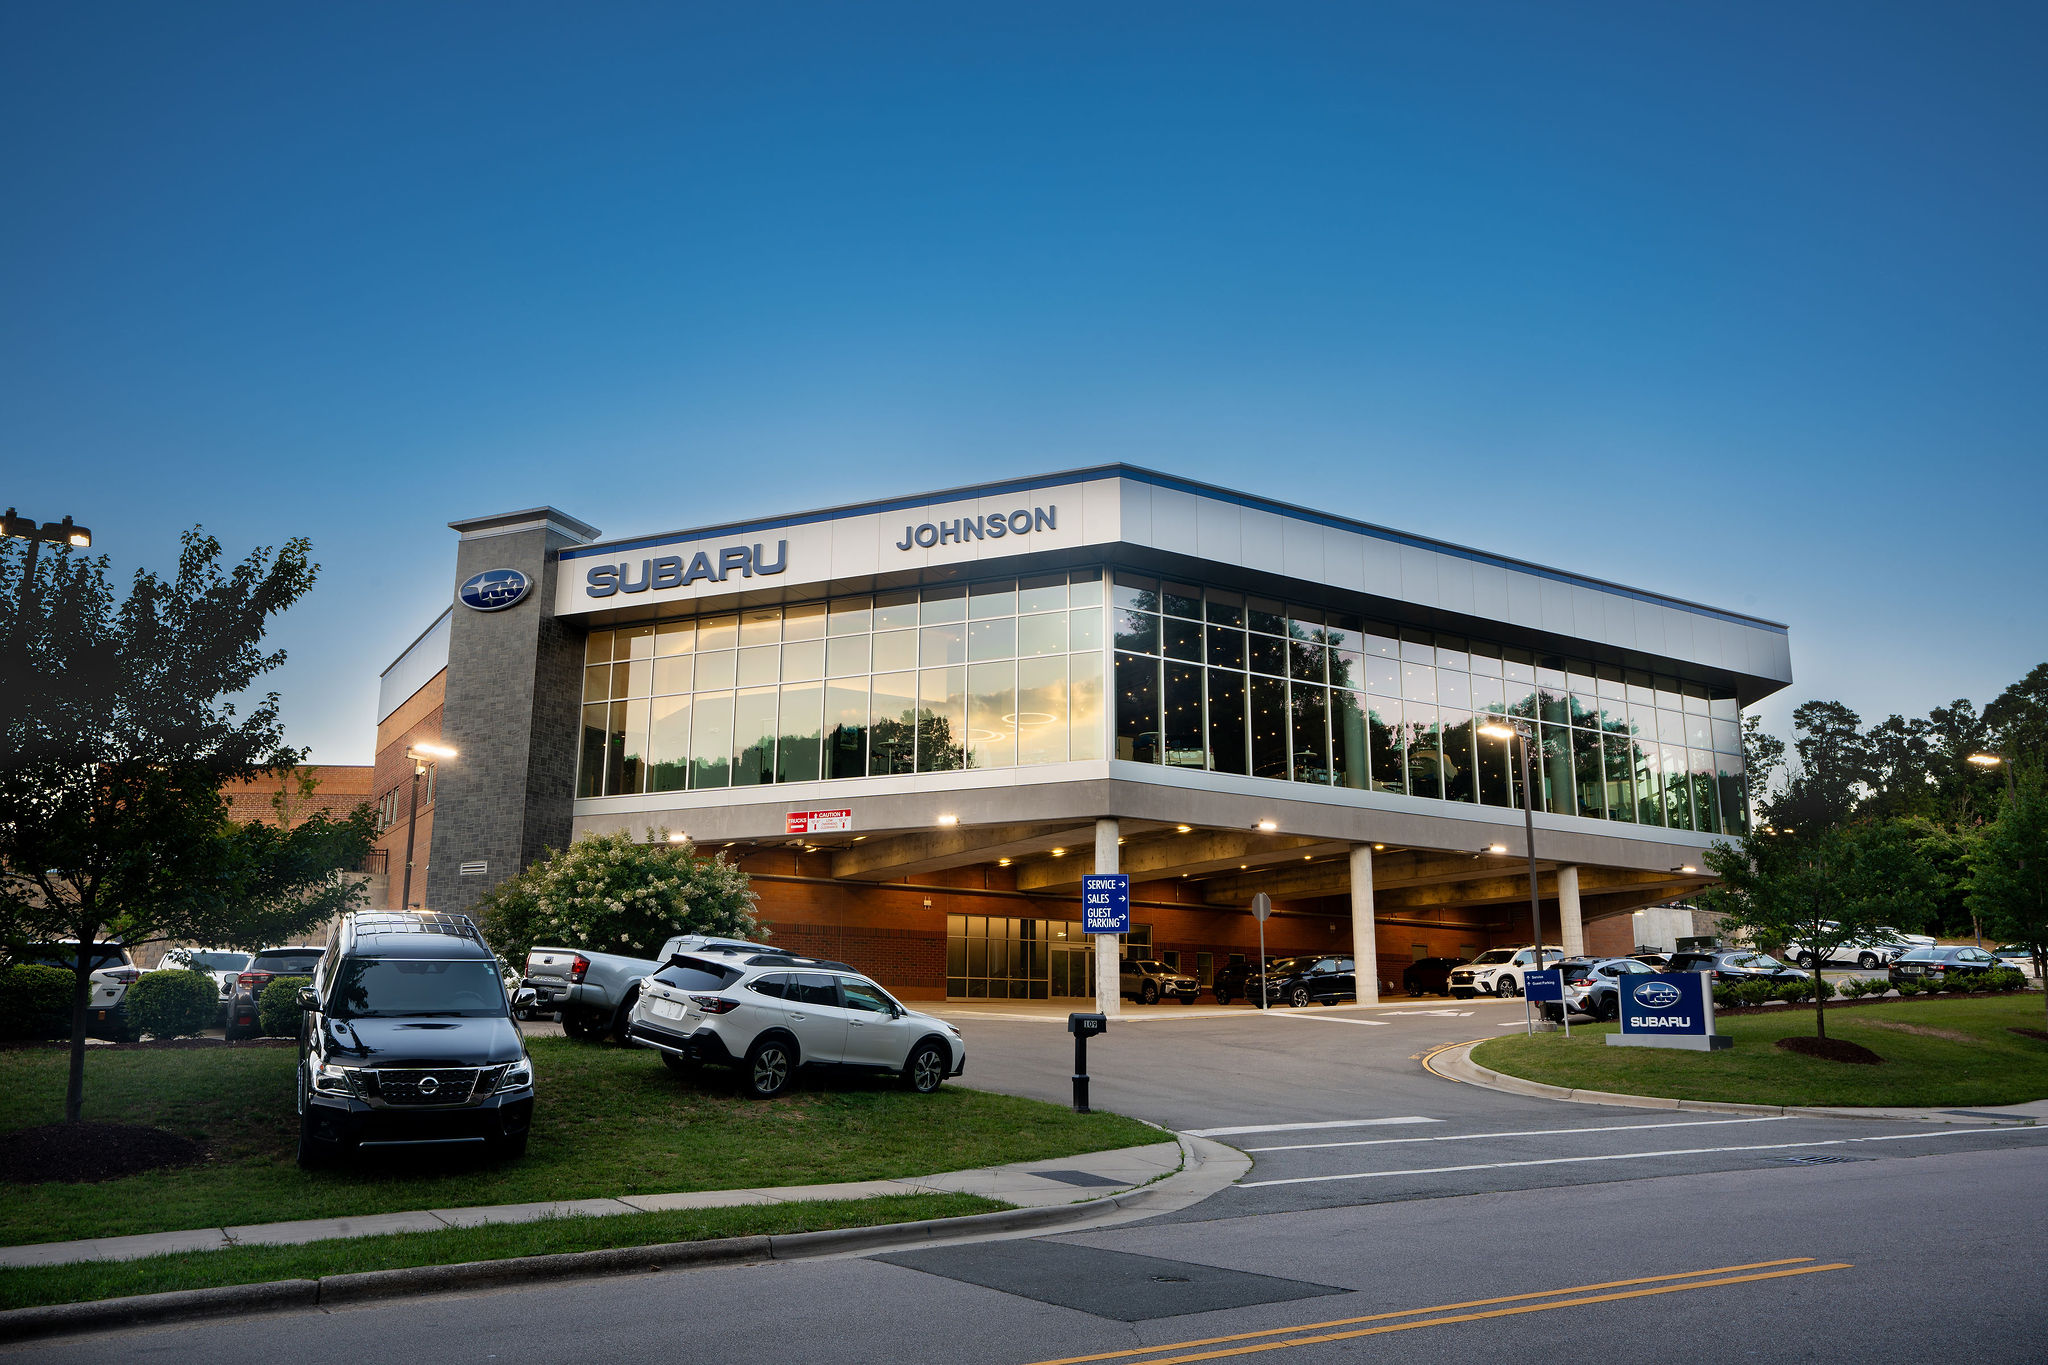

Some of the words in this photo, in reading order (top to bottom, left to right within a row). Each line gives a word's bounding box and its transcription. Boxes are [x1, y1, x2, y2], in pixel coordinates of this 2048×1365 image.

[896, 505, 1056, 550] JOHNSON
[586, 540, 787, 598] SUBARU
[1087, 880, 1116, 889] SERVICE
[1087, 894, 1109, 903] SALES
[1087, 908, 1111, 917] GUEST
[1087, 918, 1120, 927] PARKING
[1084, 1020, 1098, 1029] 109
[1630, 1016, 1690, 1027] SUBARU
